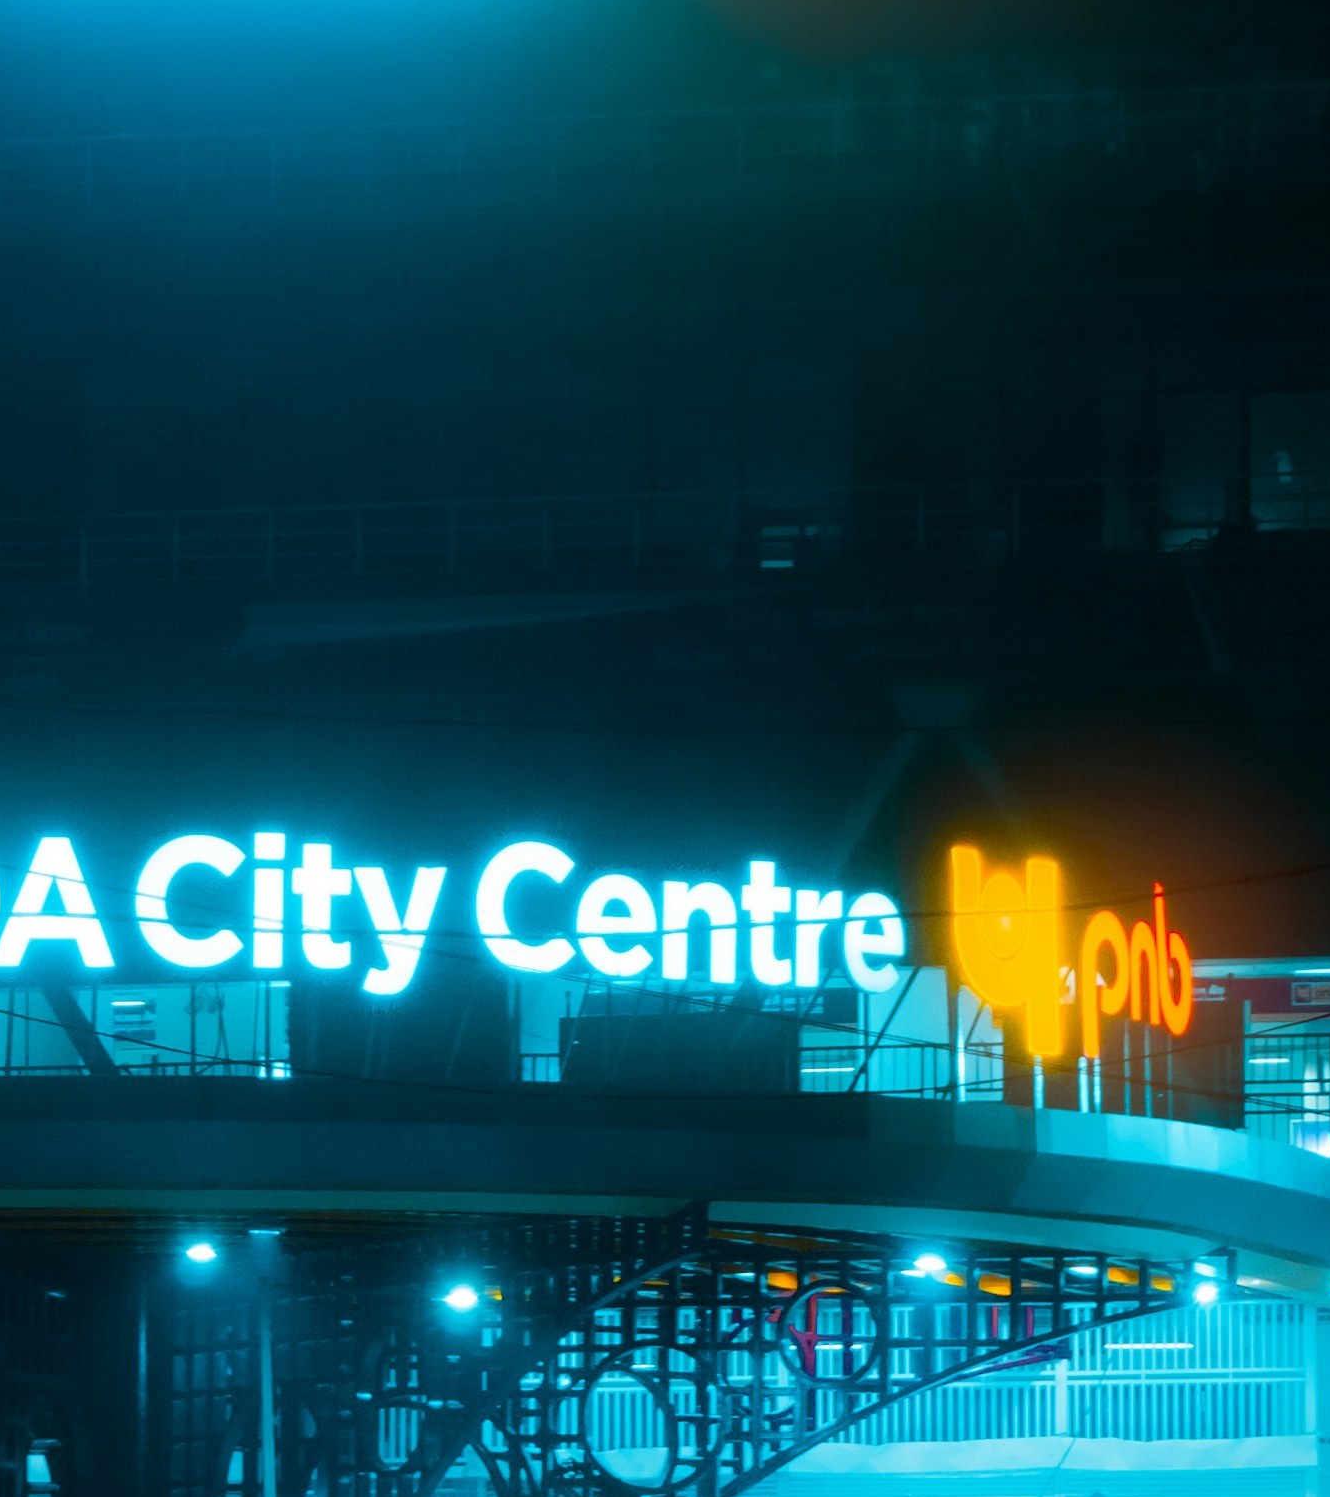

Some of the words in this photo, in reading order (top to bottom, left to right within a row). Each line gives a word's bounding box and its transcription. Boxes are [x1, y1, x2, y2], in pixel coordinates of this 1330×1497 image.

[133, 831, 448, 1007] City
[475, 840, 905, 993] Centre
[1079, 880, 1195, 1059] pnb
